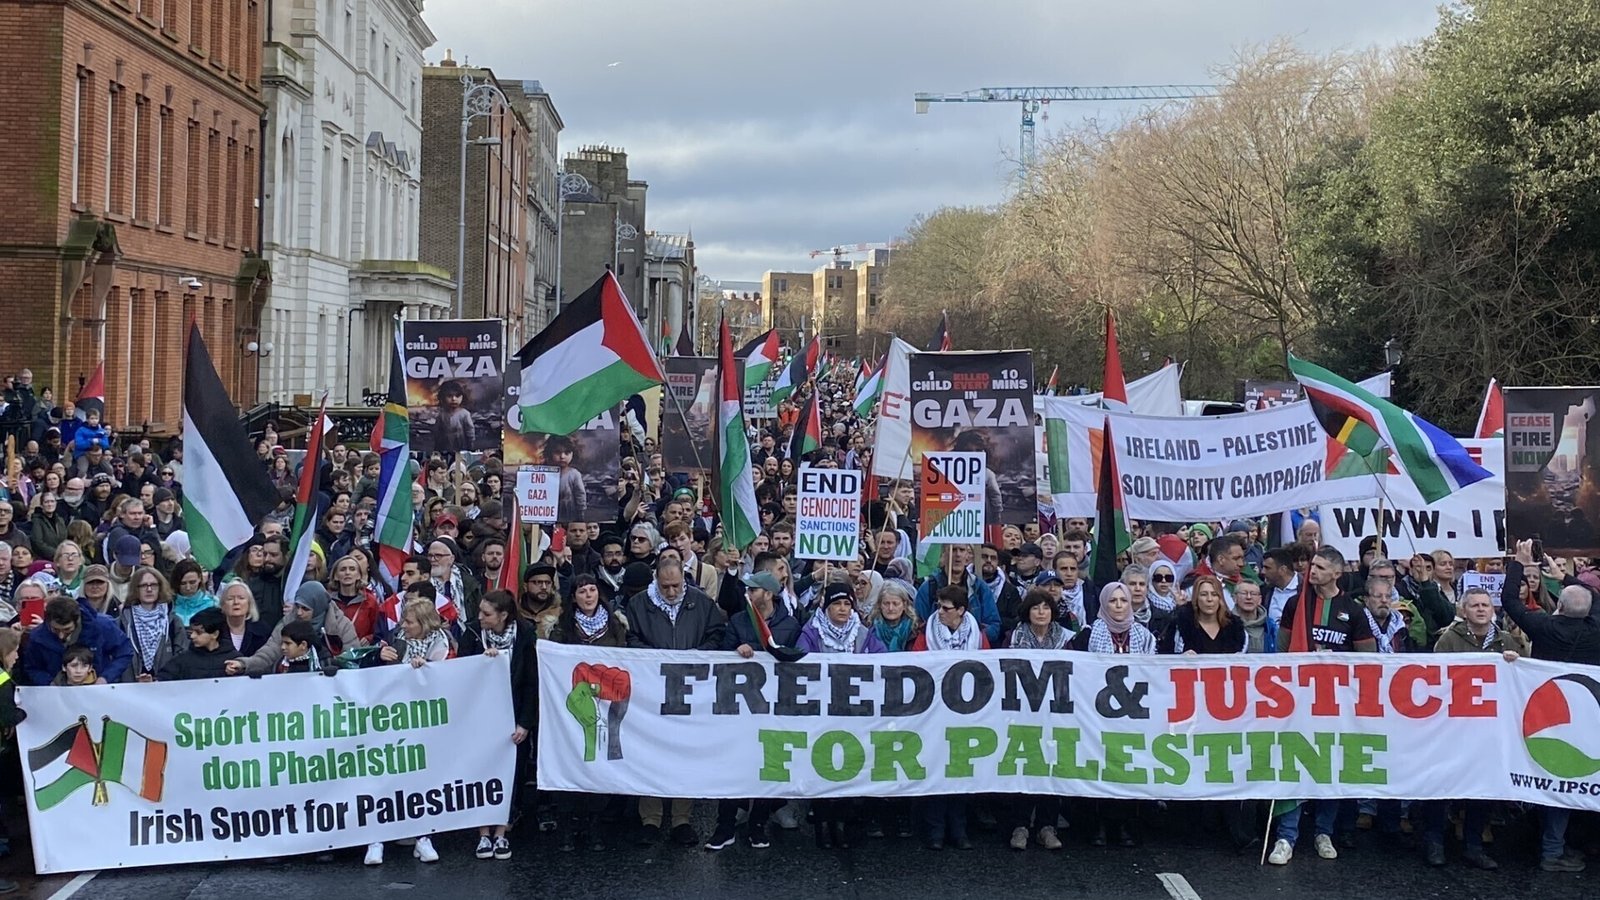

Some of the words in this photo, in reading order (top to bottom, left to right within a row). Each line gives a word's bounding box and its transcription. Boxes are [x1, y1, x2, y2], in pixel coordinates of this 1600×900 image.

[477, 333, 491, 342] 10
[405, 342, 438, 350] CHILD
[469, 341, 498, 350] MINS
[447, 350, 458, 358] IN
[406, 355, 498, 379] GAZA
[669, 375, 695, 384] CEASE
[927, 370, 935, 380] 1
[953, 373, 990, 381] KILLED
[1001, 369, 1019, 379] 10
[912, 380, 952, 391] CHILD
[953, 381, 990, 390] EVERY
[992, 379, 1028, 390] MINS
[964, 391, 978, 400] IN
[913, 398, 1029, 429] GAZA
[1511, 416, 1551, 427] CEASE
[1125, 435, 1201, 461] IRELAND
[1222, 420, 1318, 458] PALESTINE
[1511, 431, 1551, 447] FIRE
[927, 456, 982, 485] STOP
[531, 473, 546, 483] END
[801, 472, 857, 494] END
[1122, 473, 1225, 501] SOLIDARITY
[1230, 459, 1323, 499] CAMPAIGN
[528, 489, 547, 500] GAZA
[520, 505, 555, 517] GENOCIDE
[800, 497, 857, 519] GENOCIDE
[800, 520, 856, 532] SANCTIONS
[926, 509, 981, 538] GENOCIDE
[799, 533, 856, 557] NOW
[1480, 583, 1495, 591] THE
[660, 659, 1074, 716] FREEDOM
[1094, 664, 1150, 720] &
[1167, 663, 1498, 723] JUSTICE
[174, 709, 260, 751] Spórt
[267, 710, 305, 742] na
[758, 728, 926, 782] FOR
[944, 724, 1388, 785] PALESTINE
[202, 755, 262, 791] don
[268, 738, 427, 787] Phalaistín
[129, 807, 204, 846] Irish
[210, 803, 298, 843] Sport
[303, 799, 348, 833] for
[356, 778, 504, 827] Palestine
